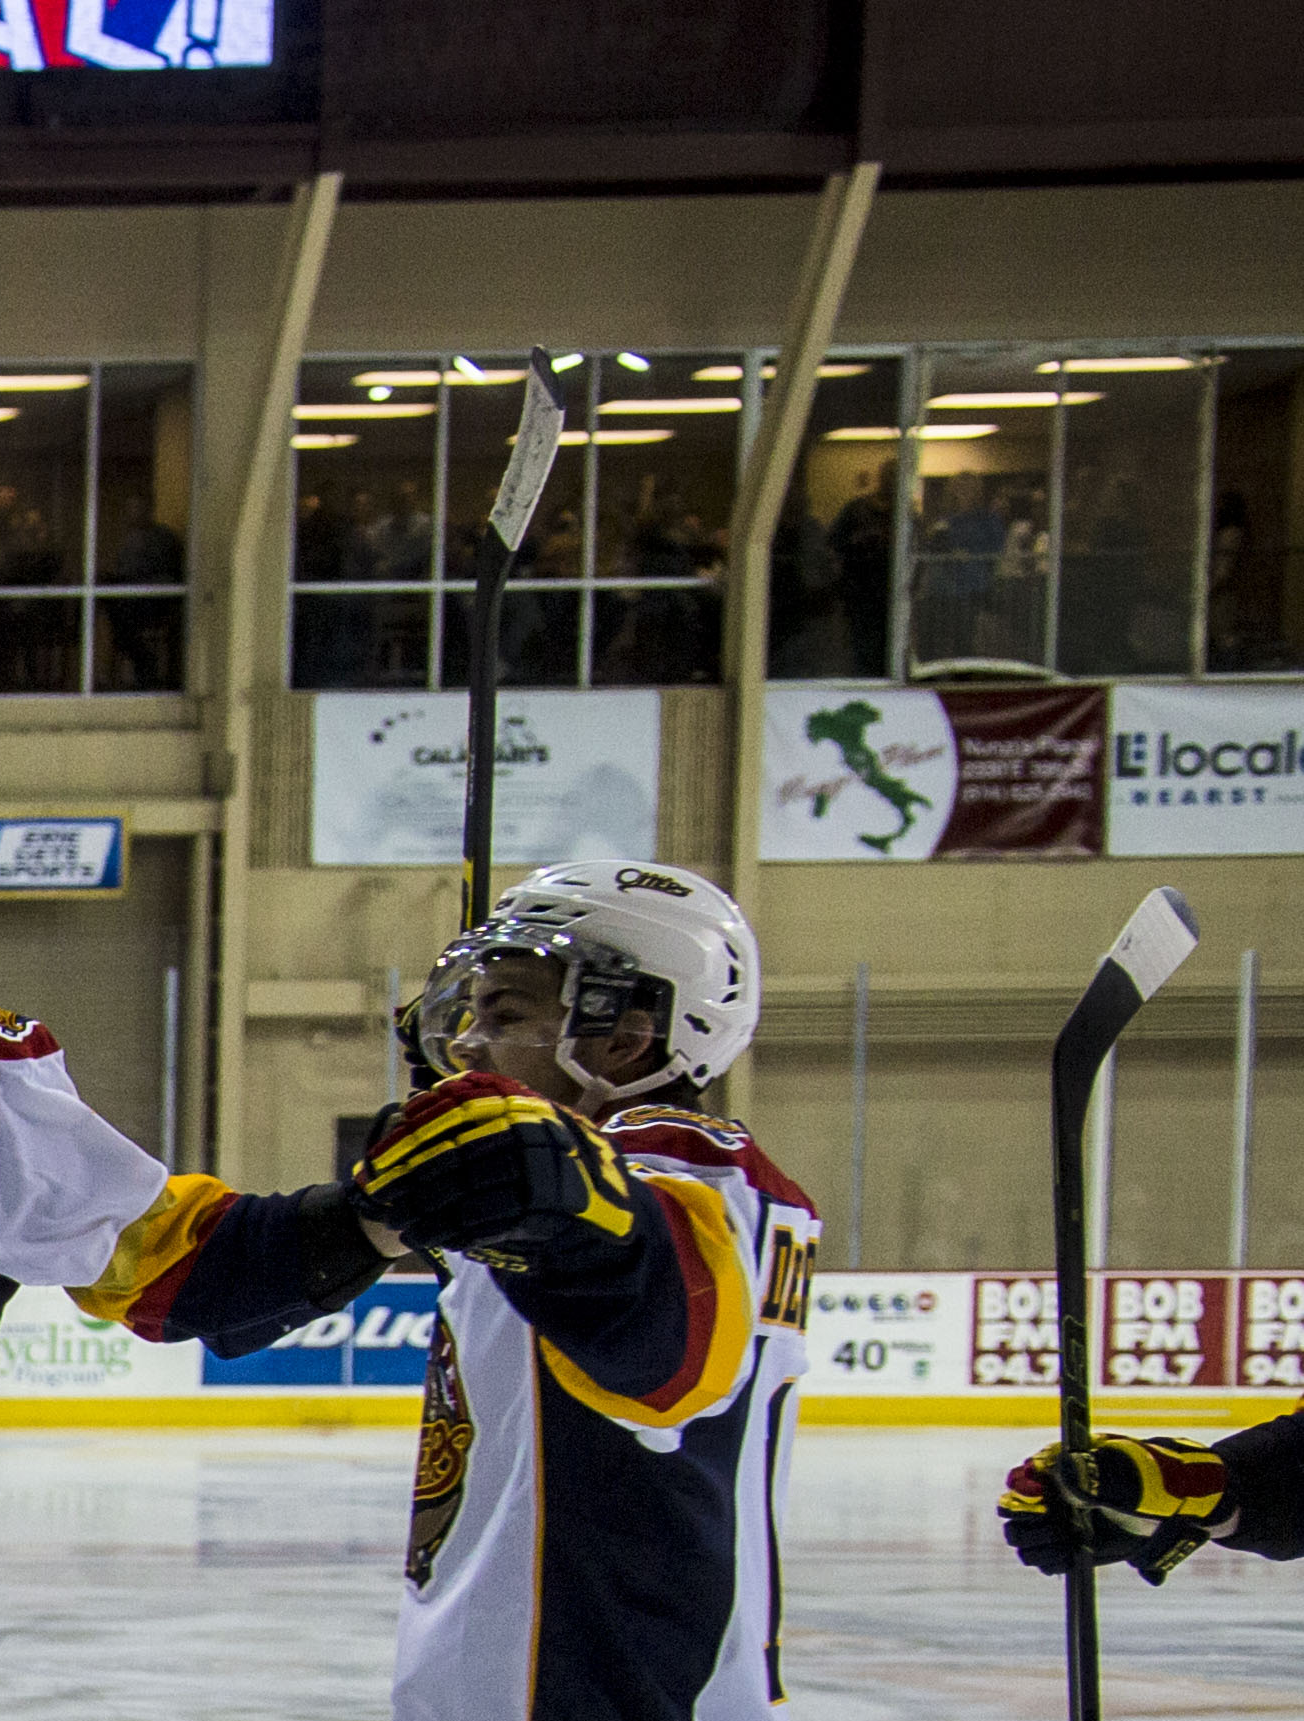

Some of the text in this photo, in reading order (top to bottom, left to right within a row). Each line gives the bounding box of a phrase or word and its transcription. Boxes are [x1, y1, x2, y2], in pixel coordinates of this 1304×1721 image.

[1158, 729, 1304, 778] local
[1114, 1280, 1204, 1321] BOB
[1249, 1280, 1304, 1321] BO
[977, 1321, 1060, 1351] FM
[1113, 1322, 1201, 1351] FM
[832, 1339, 887, 1371] 40
[972, 1352, 1062, 1385] 94.7
[1108, 1353, 1205, 1386] 94.7
